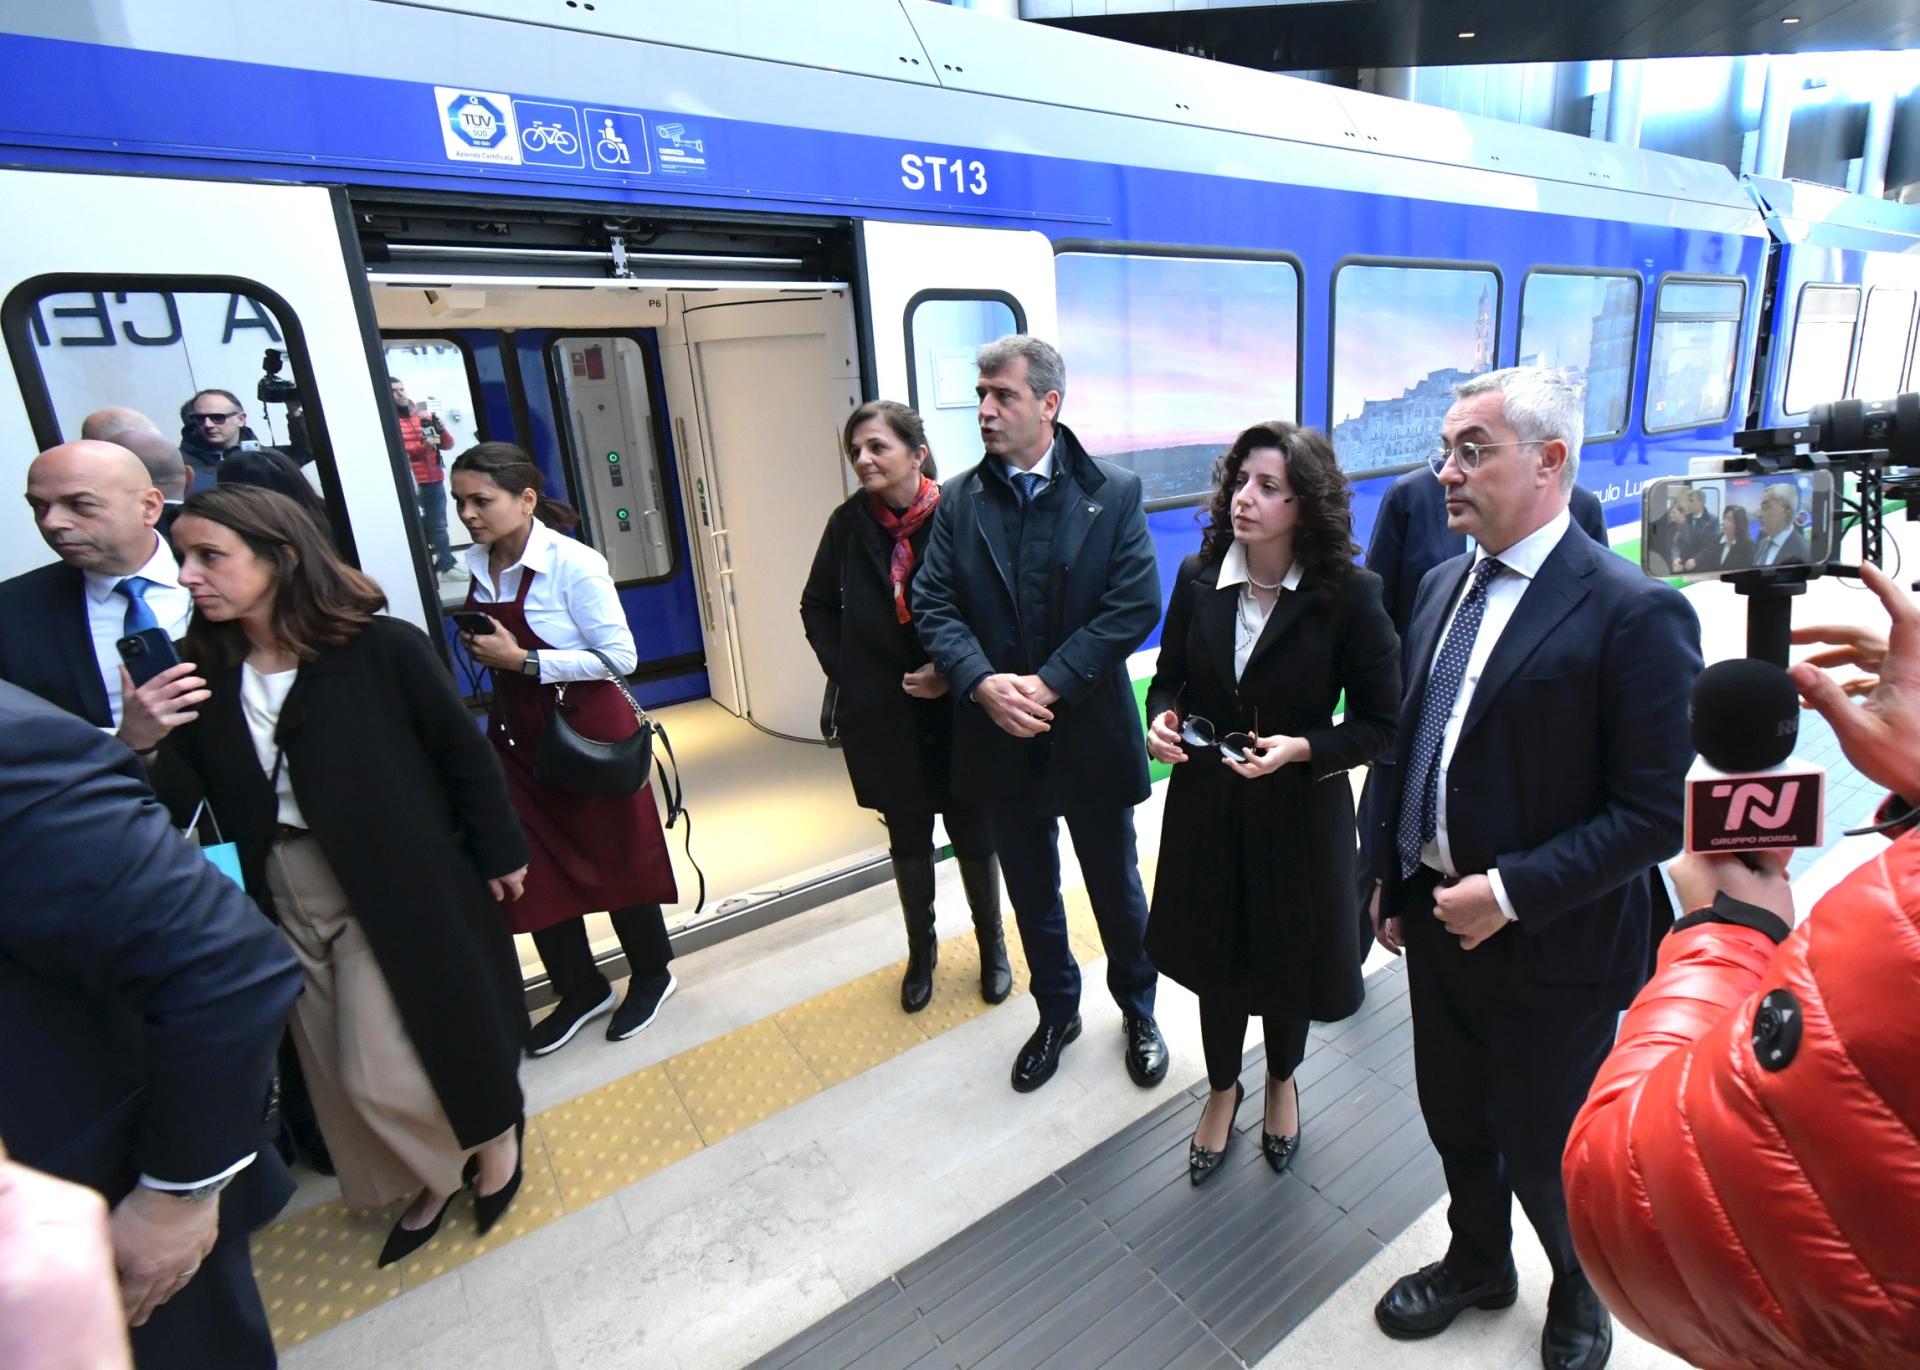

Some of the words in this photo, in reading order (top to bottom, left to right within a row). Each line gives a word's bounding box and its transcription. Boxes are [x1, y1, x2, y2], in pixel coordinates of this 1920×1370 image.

[901, 153, 988, 196] ST13
[648, 300, 662, 309] P6
[1710, 836, 1757, 846] GRUPPO
[1757, 834, 1798, 843] NORBA
